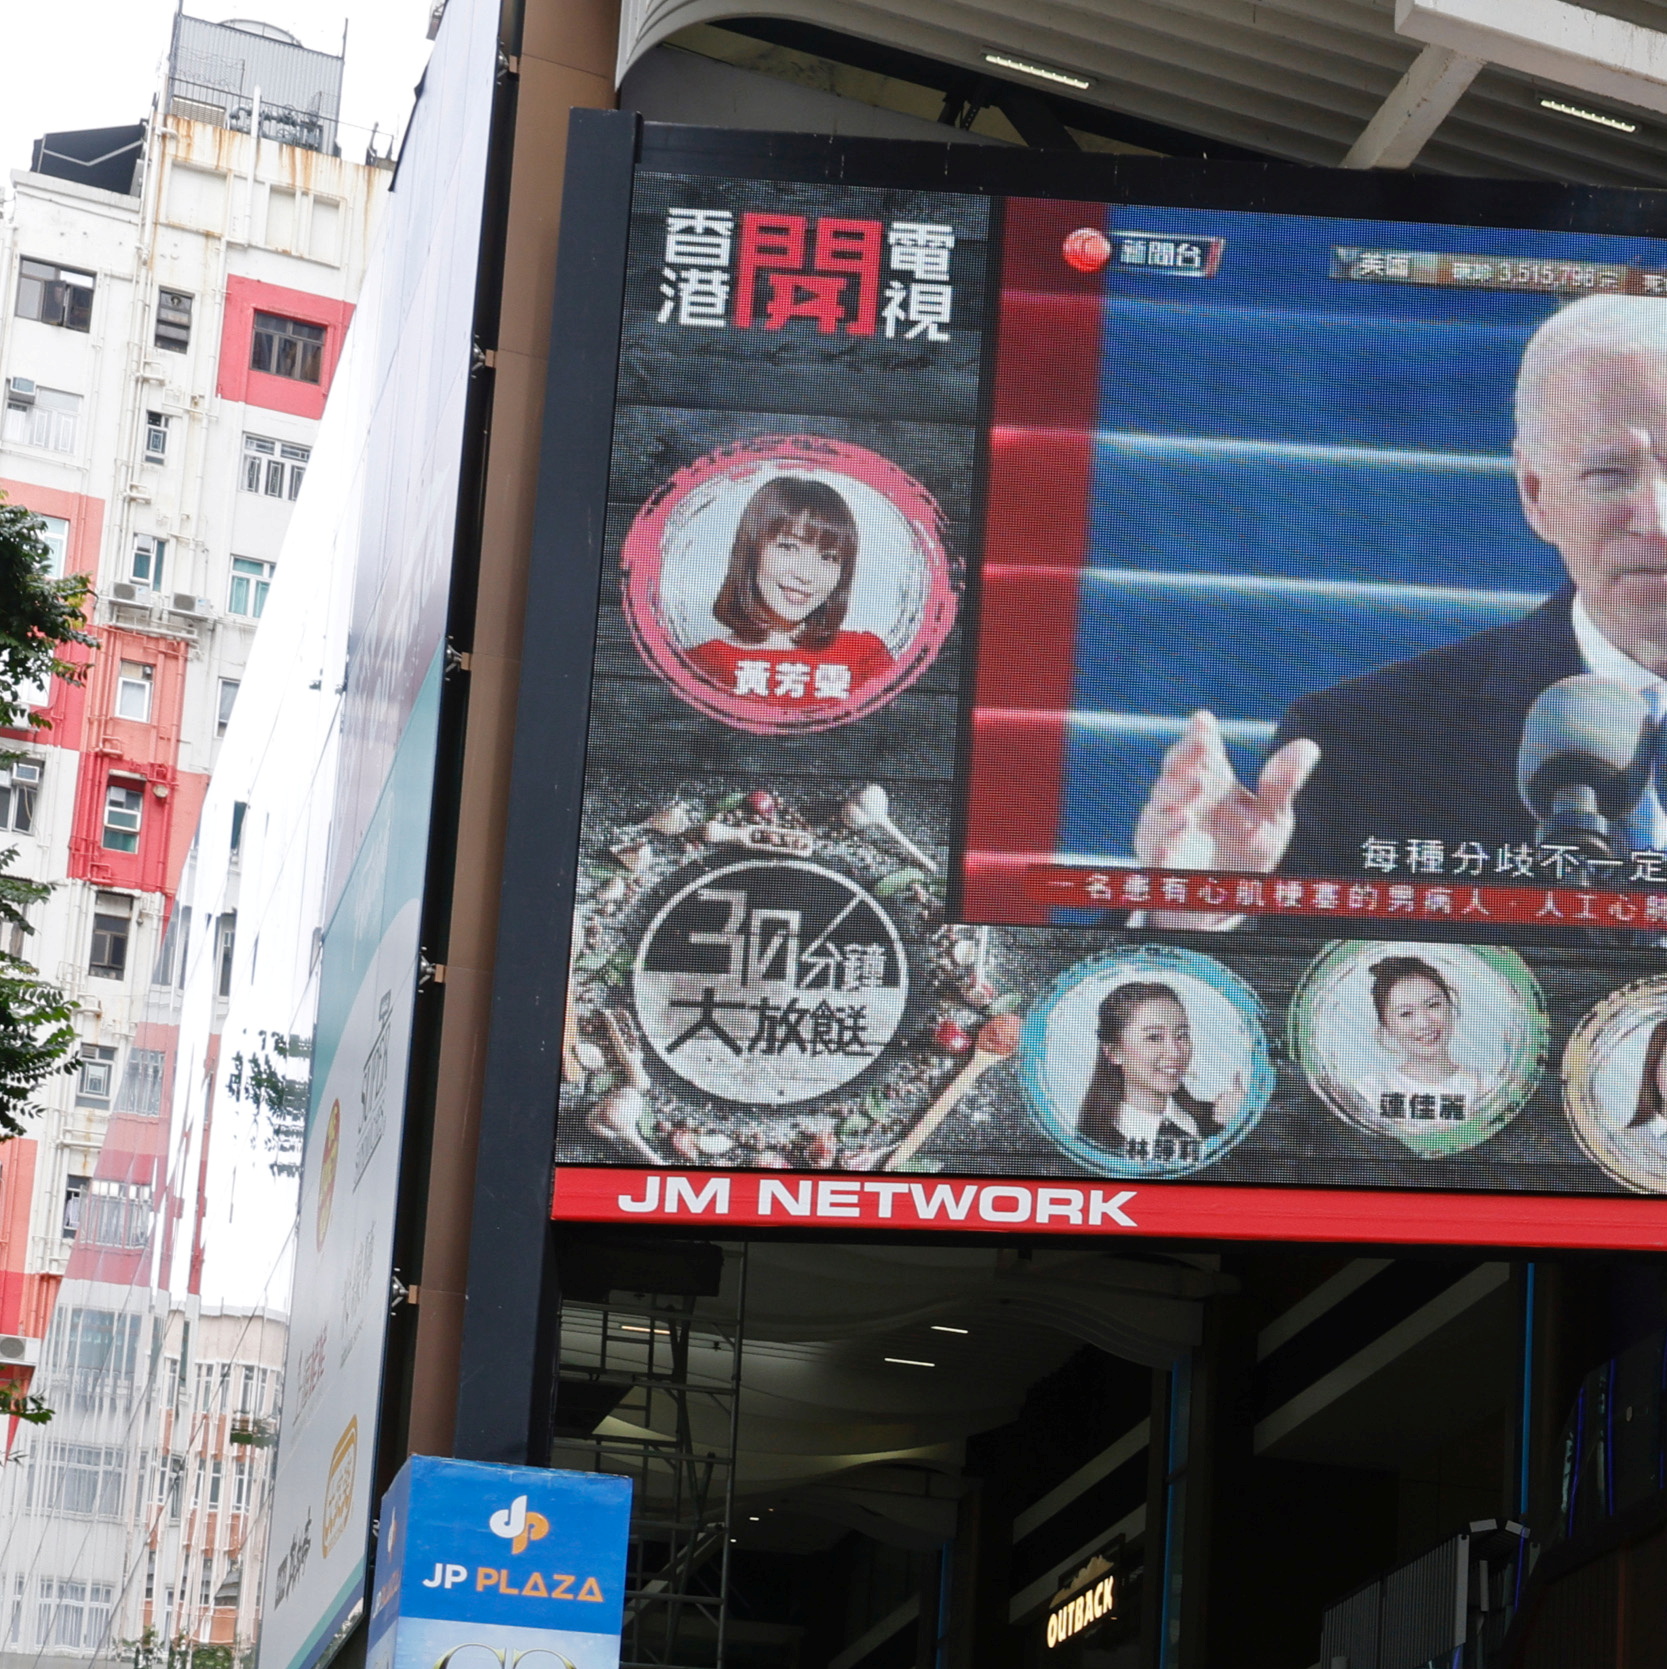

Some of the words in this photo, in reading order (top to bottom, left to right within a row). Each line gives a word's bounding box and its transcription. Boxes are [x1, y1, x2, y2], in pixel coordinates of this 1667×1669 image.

[657, 207, 734, 328] 香港
[732, 212, 884, 336] 開
[882, 221, 955, 343] 電視
[617, 1175, 731, 1215] JM
[757, 1179, 1139, 1228] NETWORK
[421, 1562, 468, 1590] JP
[475, 1566, 605, 1602] PLAZA
[1046, 1574, 1116, 1649] OUTBACK
